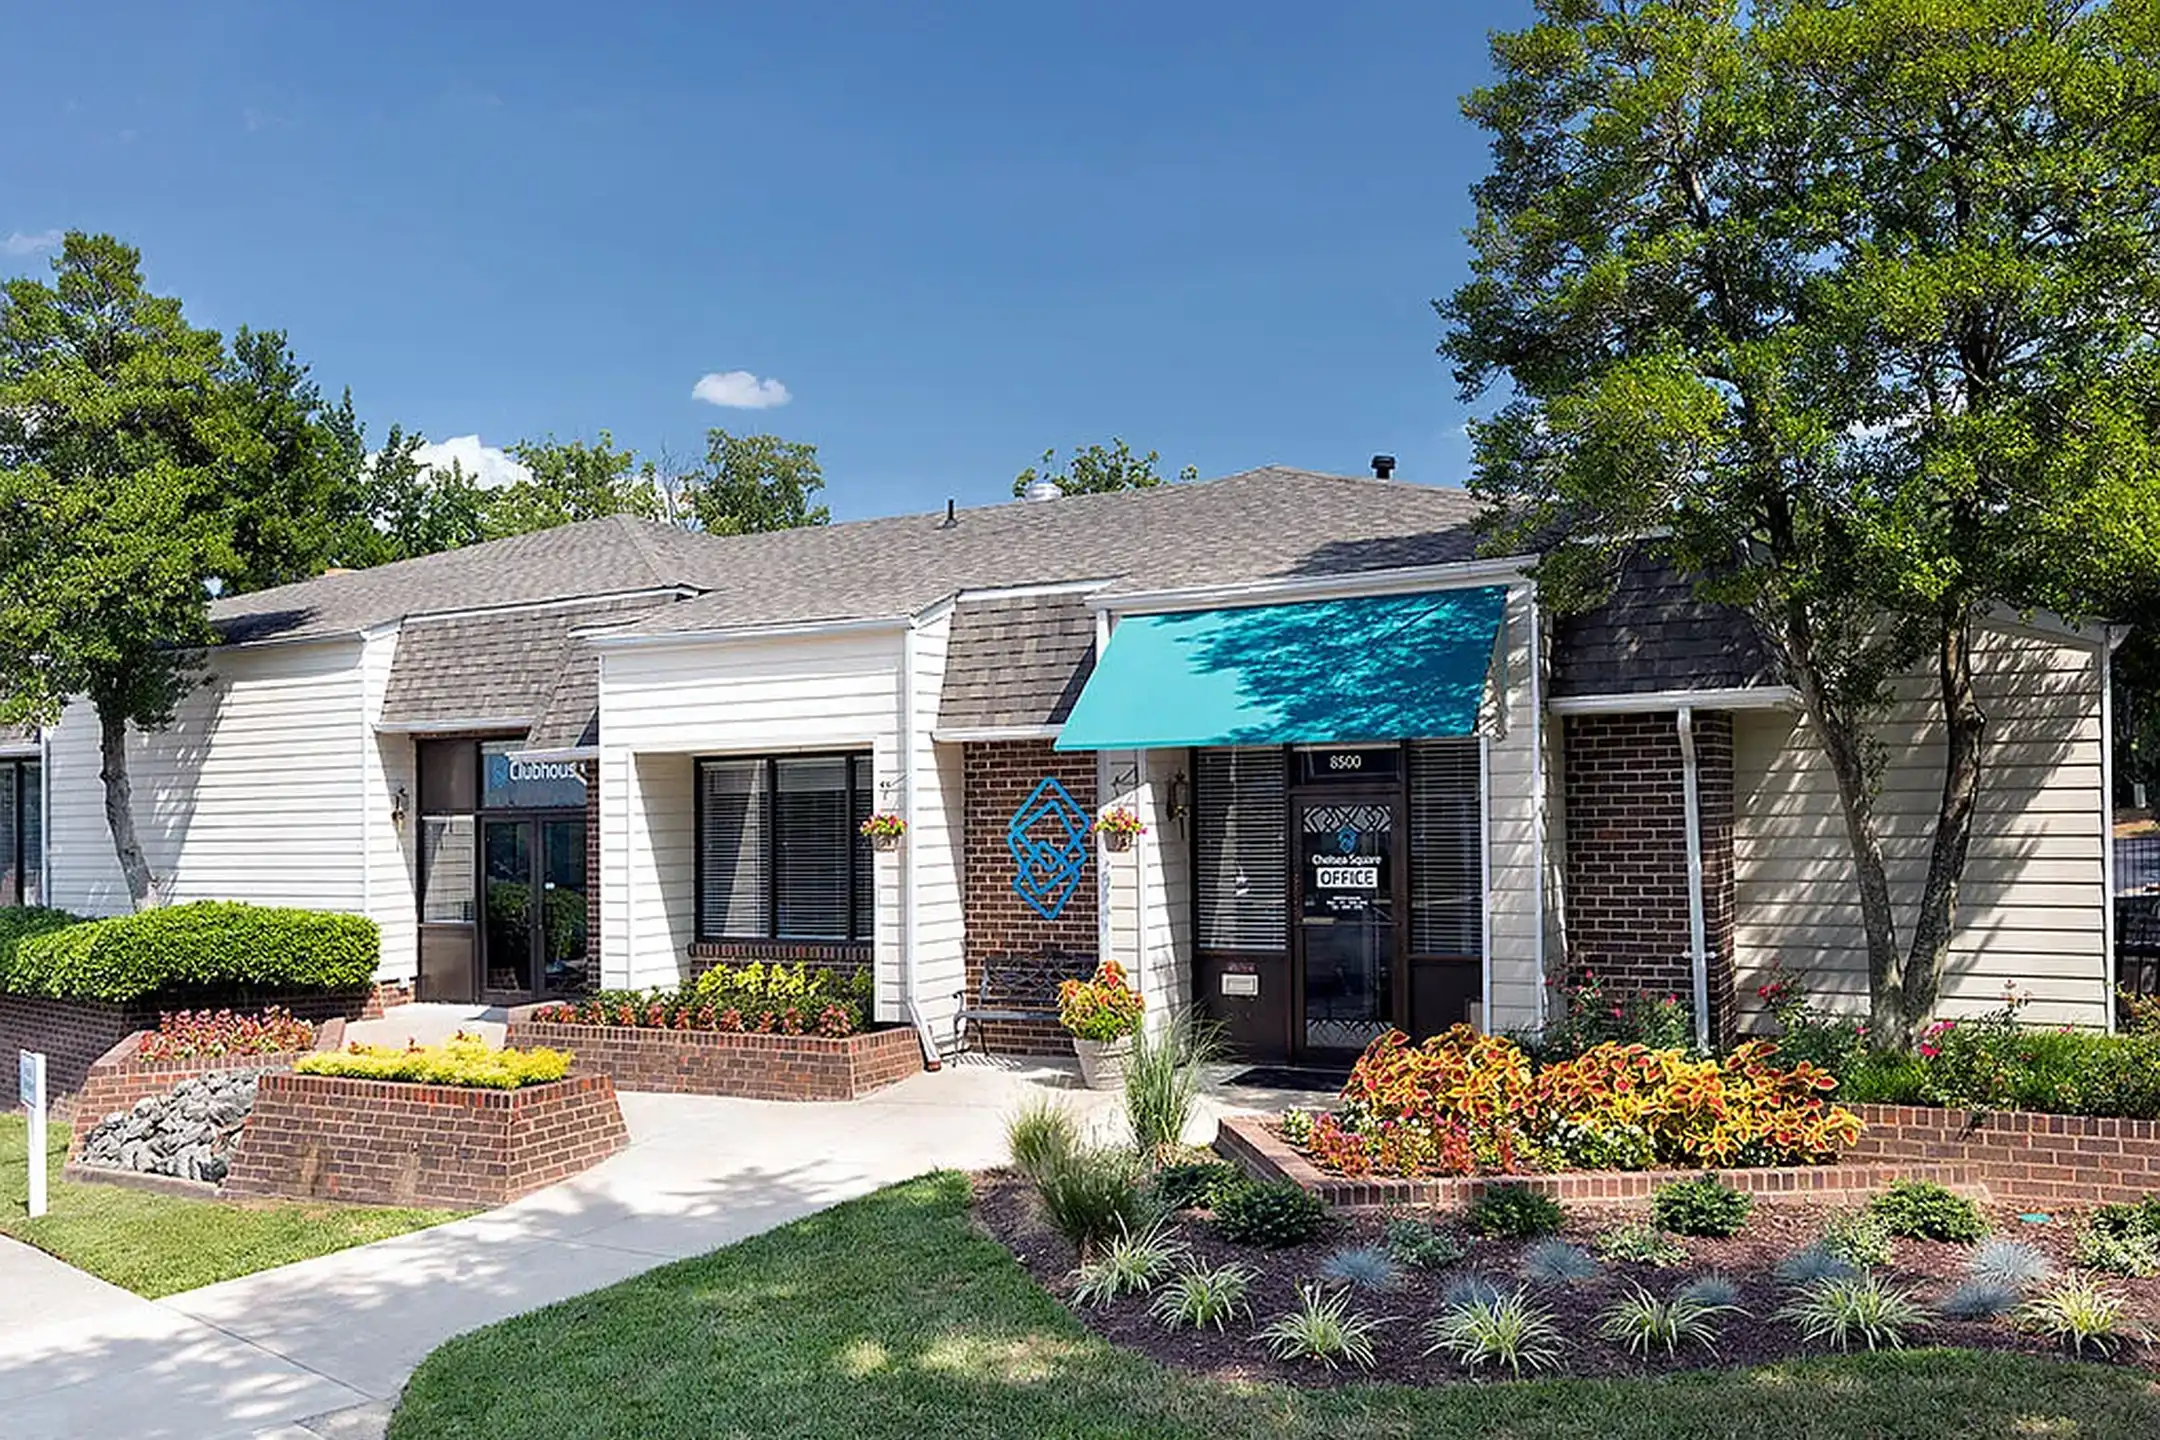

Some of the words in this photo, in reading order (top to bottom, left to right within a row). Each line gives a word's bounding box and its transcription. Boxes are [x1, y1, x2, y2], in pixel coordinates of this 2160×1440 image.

[1329, 755, 1362, 769] 8500
[509, 761, 586, 780] Clubhous
[1312, 855, 1348, 865] Chelsea
[1349, 854, 1382, 866] Square
[1320, 870, 1374, 885] OFFICE
